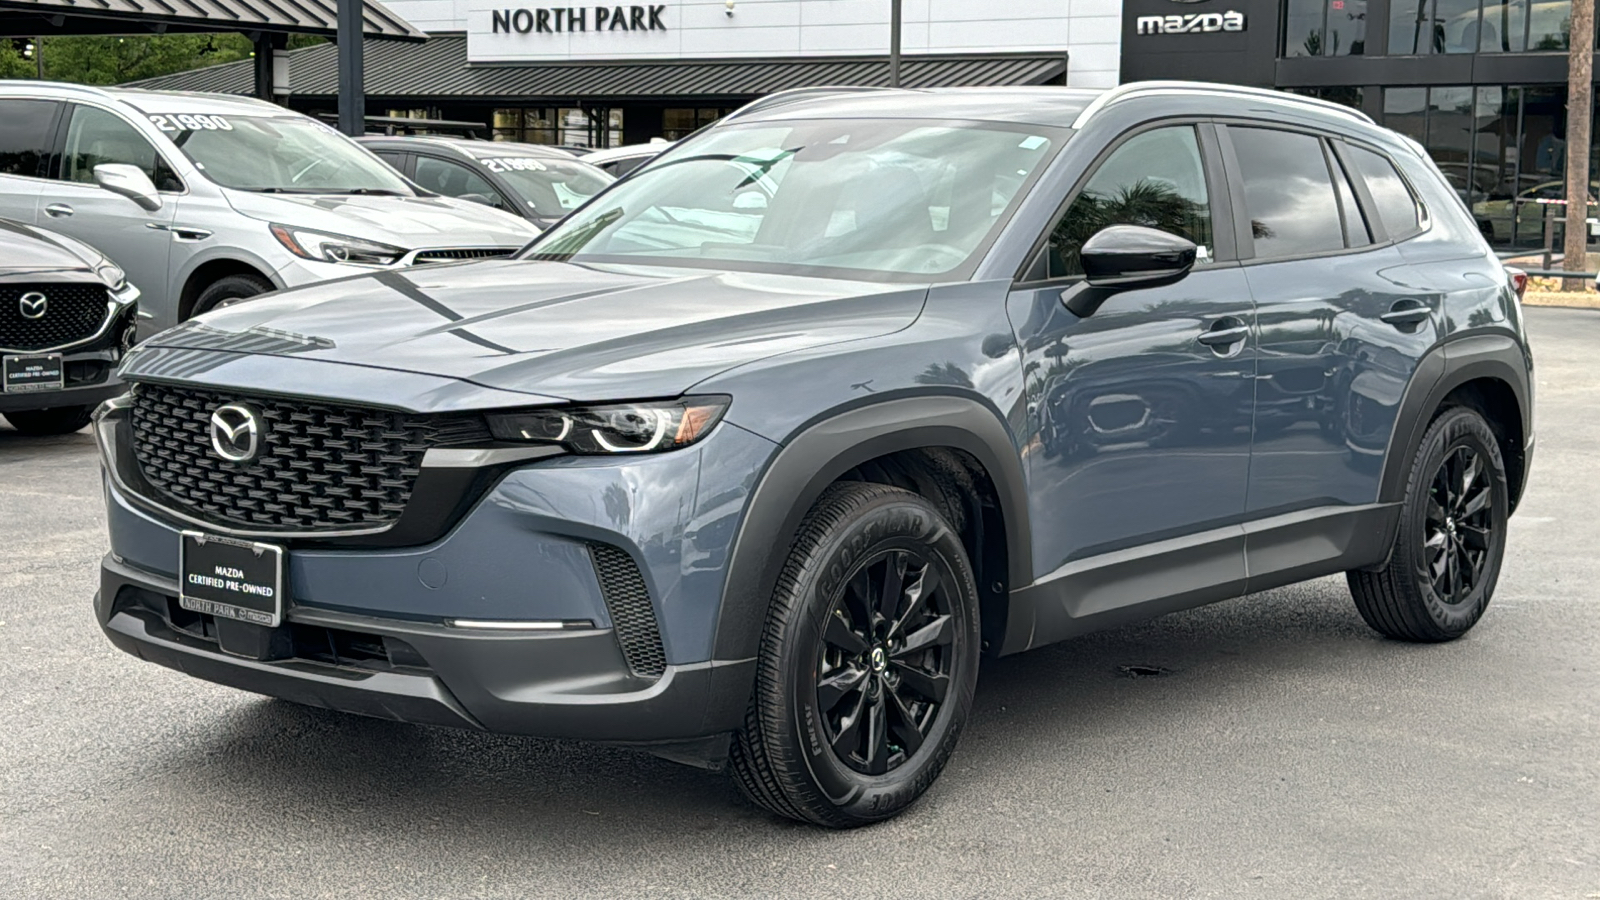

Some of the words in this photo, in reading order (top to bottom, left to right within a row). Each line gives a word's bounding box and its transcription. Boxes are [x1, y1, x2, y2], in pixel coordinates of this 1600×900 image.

[492, 8, 586, 33] NORTH
[595, 5, 667, 31] PARK
[150, 114, 233, 132] 21990
[215, 566, 244, 579] MAZDA
[189, 573, 224, 588] CERTIFIED
[226, 580, 273, 597] PRE-OWNED
[185, 598, 211, 612] NORTH
[214, 603, 235, 618] PARK
